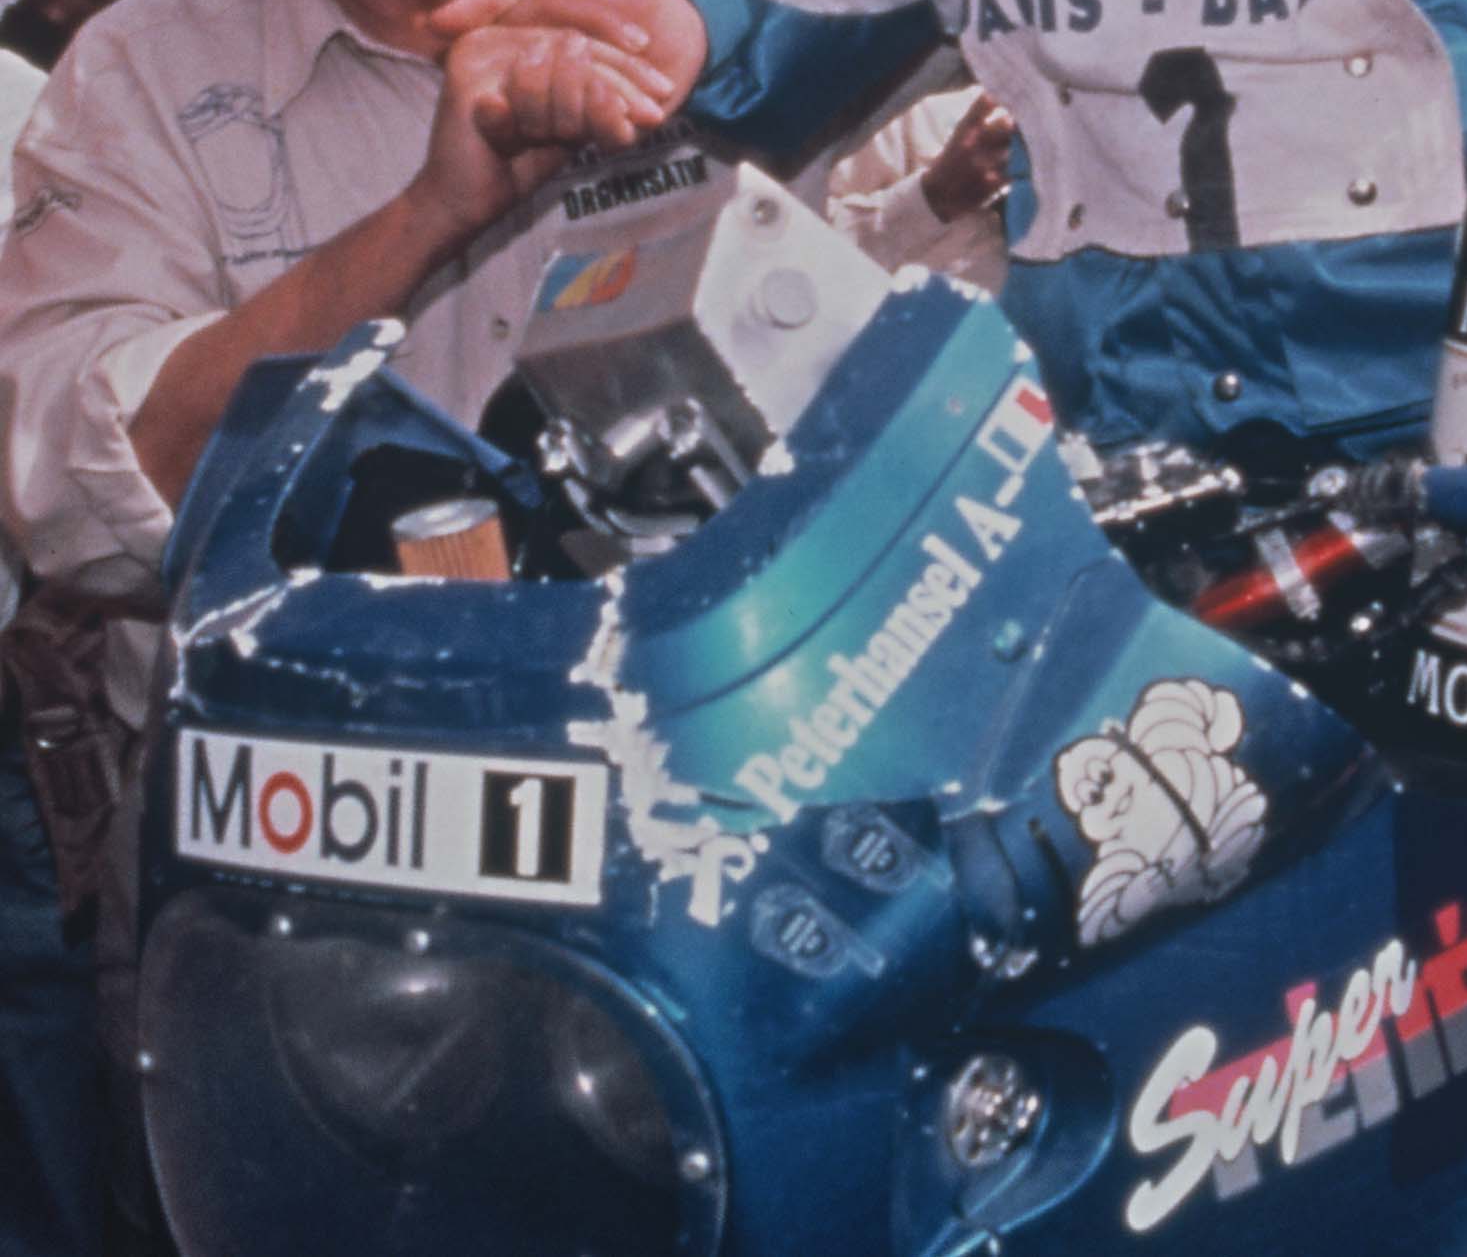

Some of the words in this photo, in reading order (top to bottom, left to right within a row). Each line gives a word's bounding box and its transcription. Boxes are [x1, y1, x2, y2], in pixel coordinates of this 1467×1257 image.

[191, 739, 429, 869] Mobil
[508, 777, 543, 877] 1
[734, 534, 982, 824] Peterhansel
[1126, 939, 1417, 1233] Super
